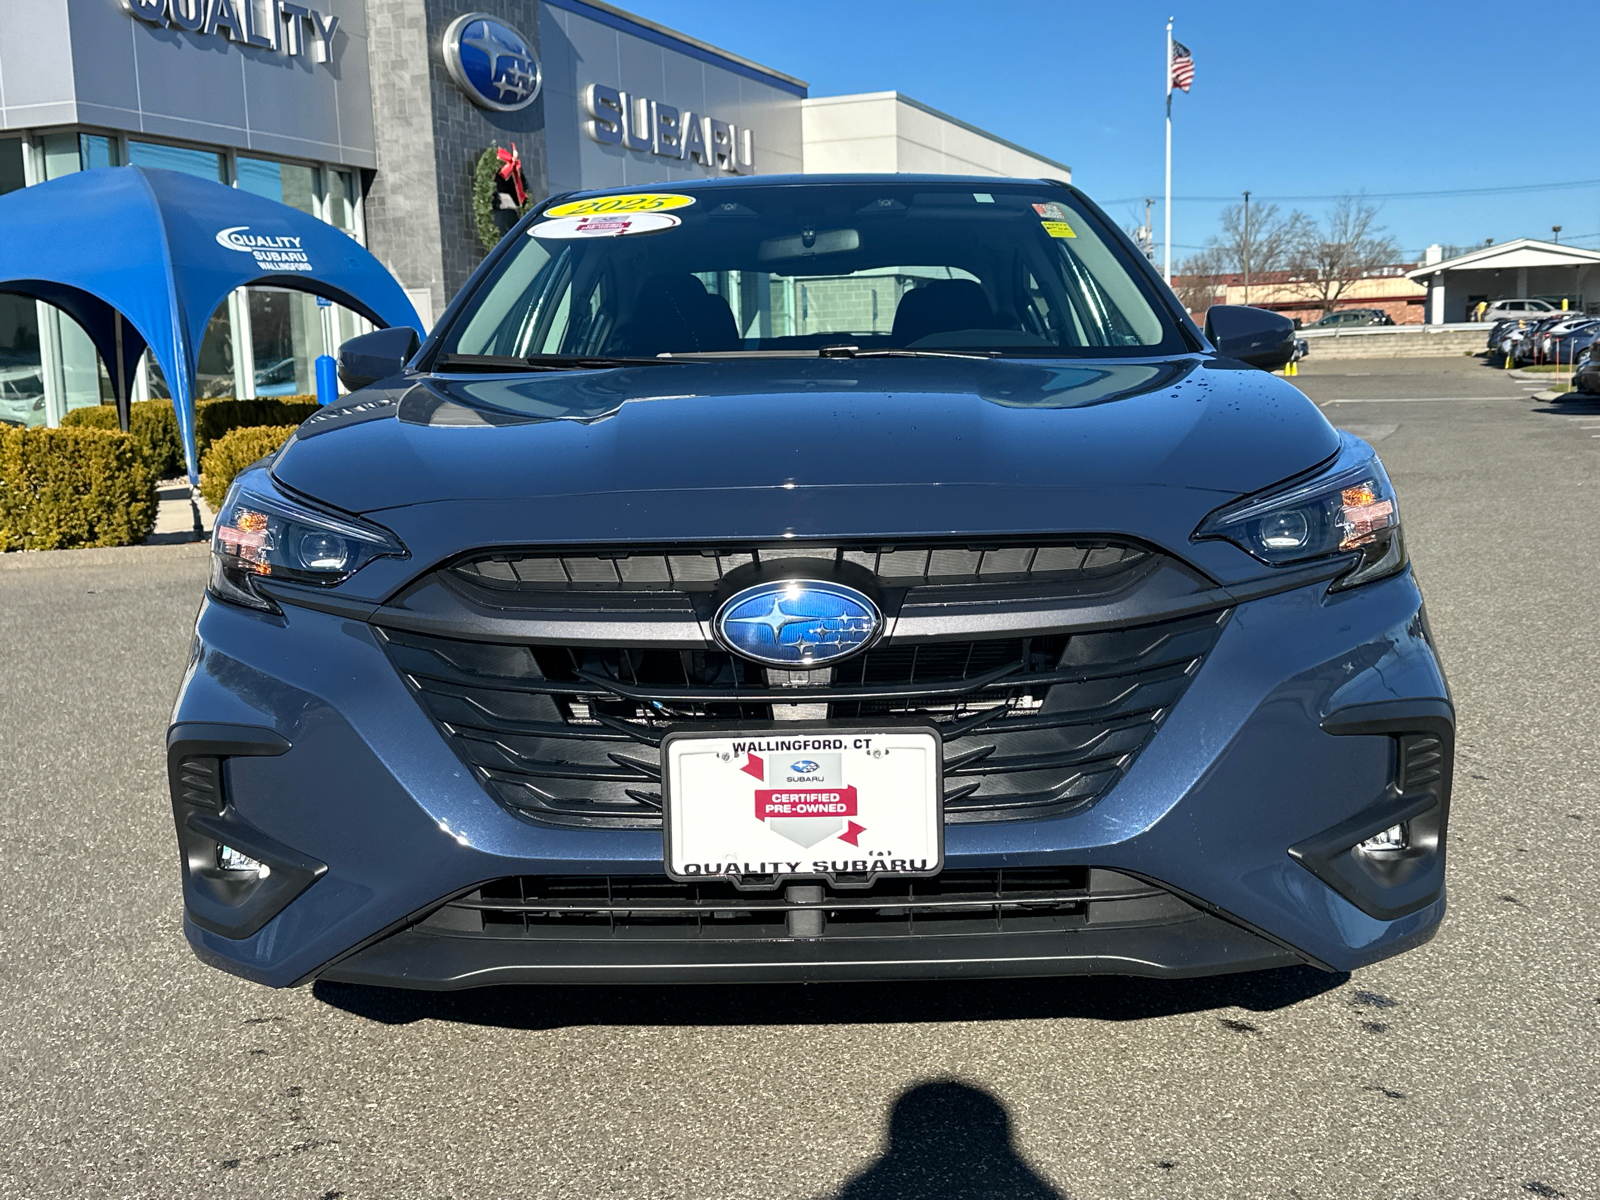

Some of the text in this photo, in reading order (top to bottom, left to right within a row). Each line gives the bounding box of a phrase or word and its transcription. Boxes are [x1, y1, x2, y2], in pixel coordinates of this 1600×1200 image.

[586, 83, 755, 175] SUBARU
[565, 197, 673, 215] 2025
[229, 233, 301, 248] QUALITY
[252, 251, 308, 262] SUBARU
[257, 261, 313, 271] WALLINGFORD
[732, 738, 872, 752] WALLINGFORD, CT
[771, 793, 840, 803] CERTIFIED
[765, 803, 847, 814] PRE-OWNED
[683, 858, 928, 876] QUALITY SUBARU
